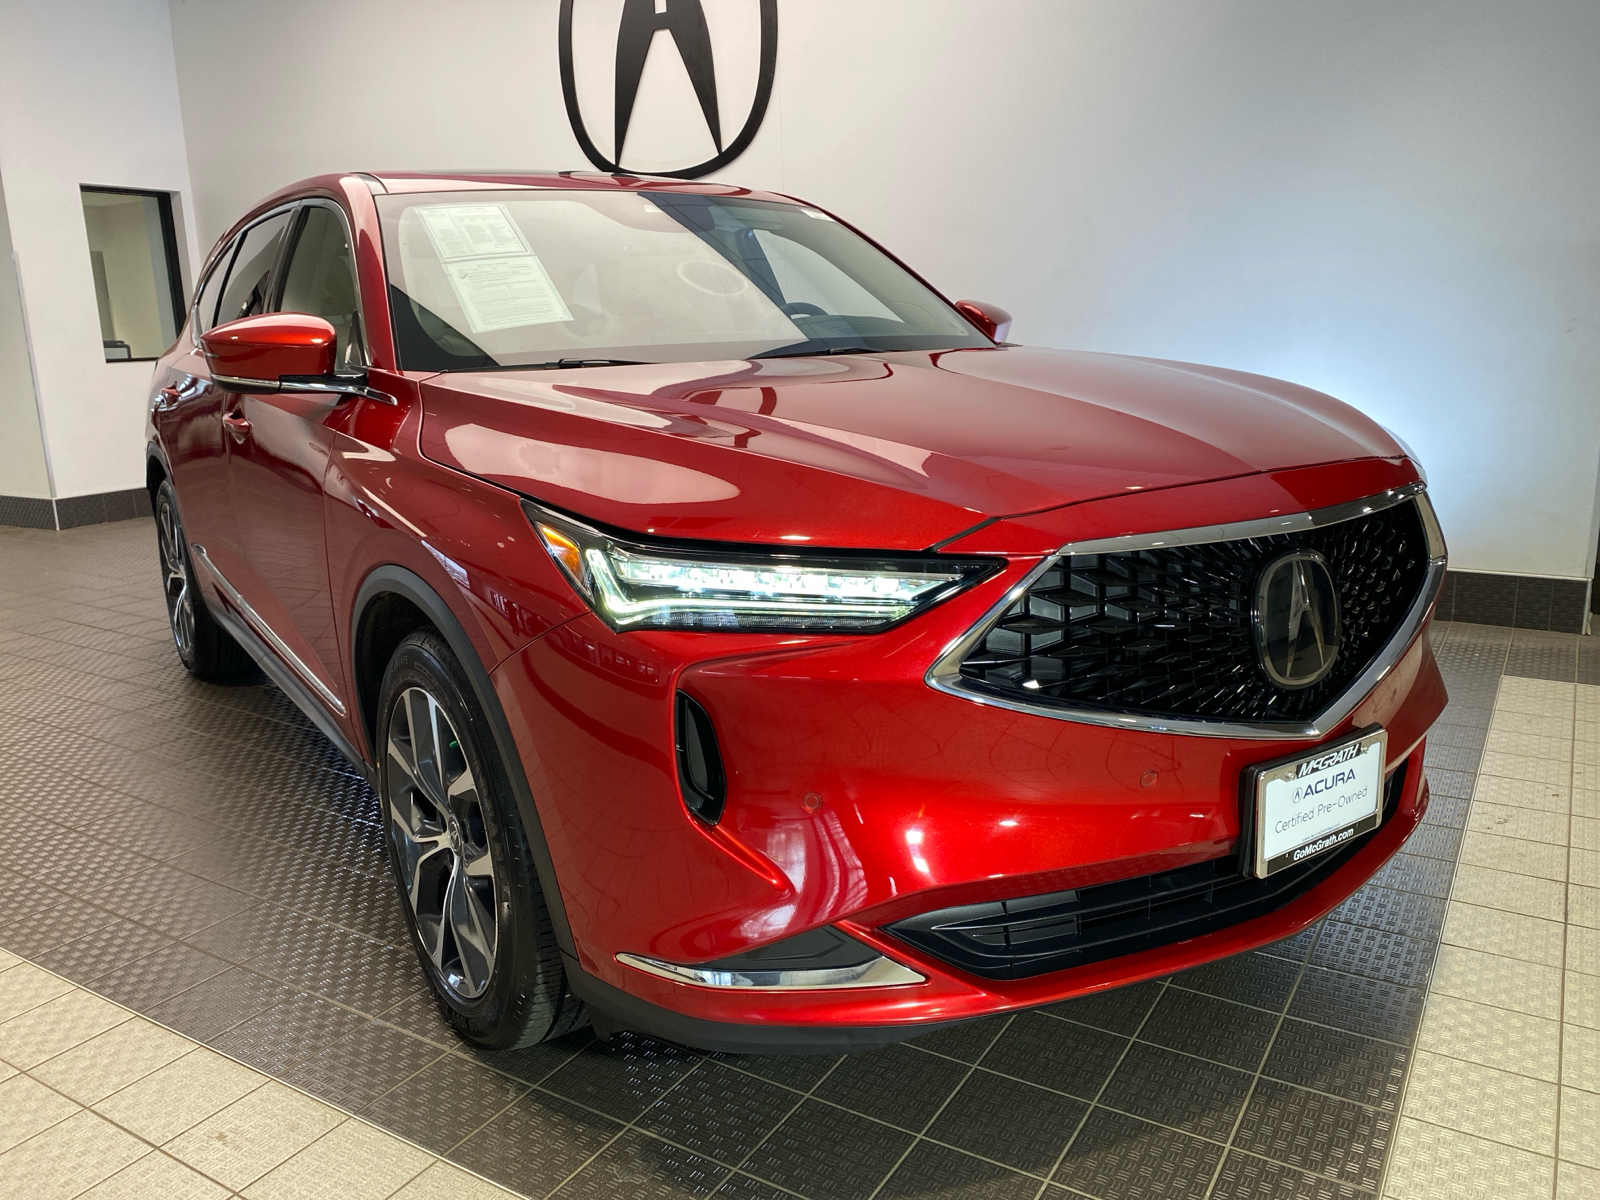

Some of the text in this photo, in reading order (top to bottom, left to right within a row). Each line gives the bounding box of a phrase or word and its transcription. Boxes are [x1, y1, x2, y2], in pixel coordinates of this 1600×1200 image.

[1303, 768, 1356, 799] ACURA
[1274, 807, 1315, 833] Certified
[1317, 785, 1368, 816] Pre-Owned
[1293, 828, 1354, 861] GoMcGrath.com
